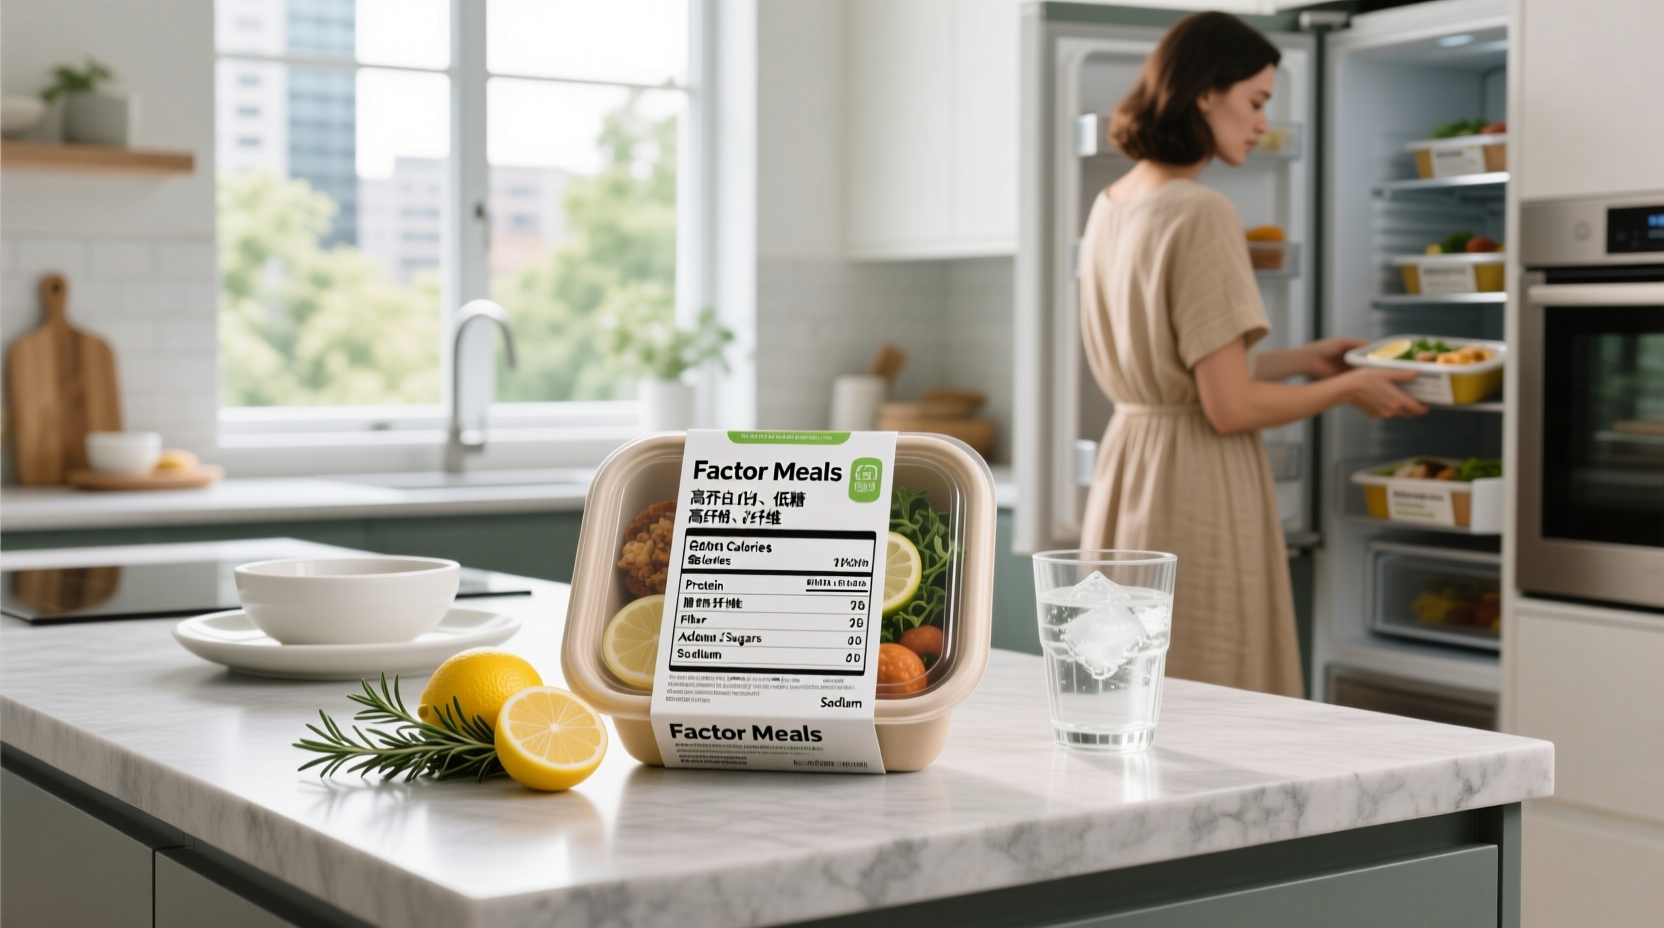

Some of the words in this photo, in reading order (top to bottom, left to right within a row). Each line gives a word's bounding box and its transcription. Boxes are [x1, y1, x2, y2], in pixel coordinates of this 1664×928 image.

[693, 460, 768, 481] Factor
[773, 461, 842, 482] Meals
[669, 723, 747, 741] Factor
[752, 724, 823, 743] Meals
